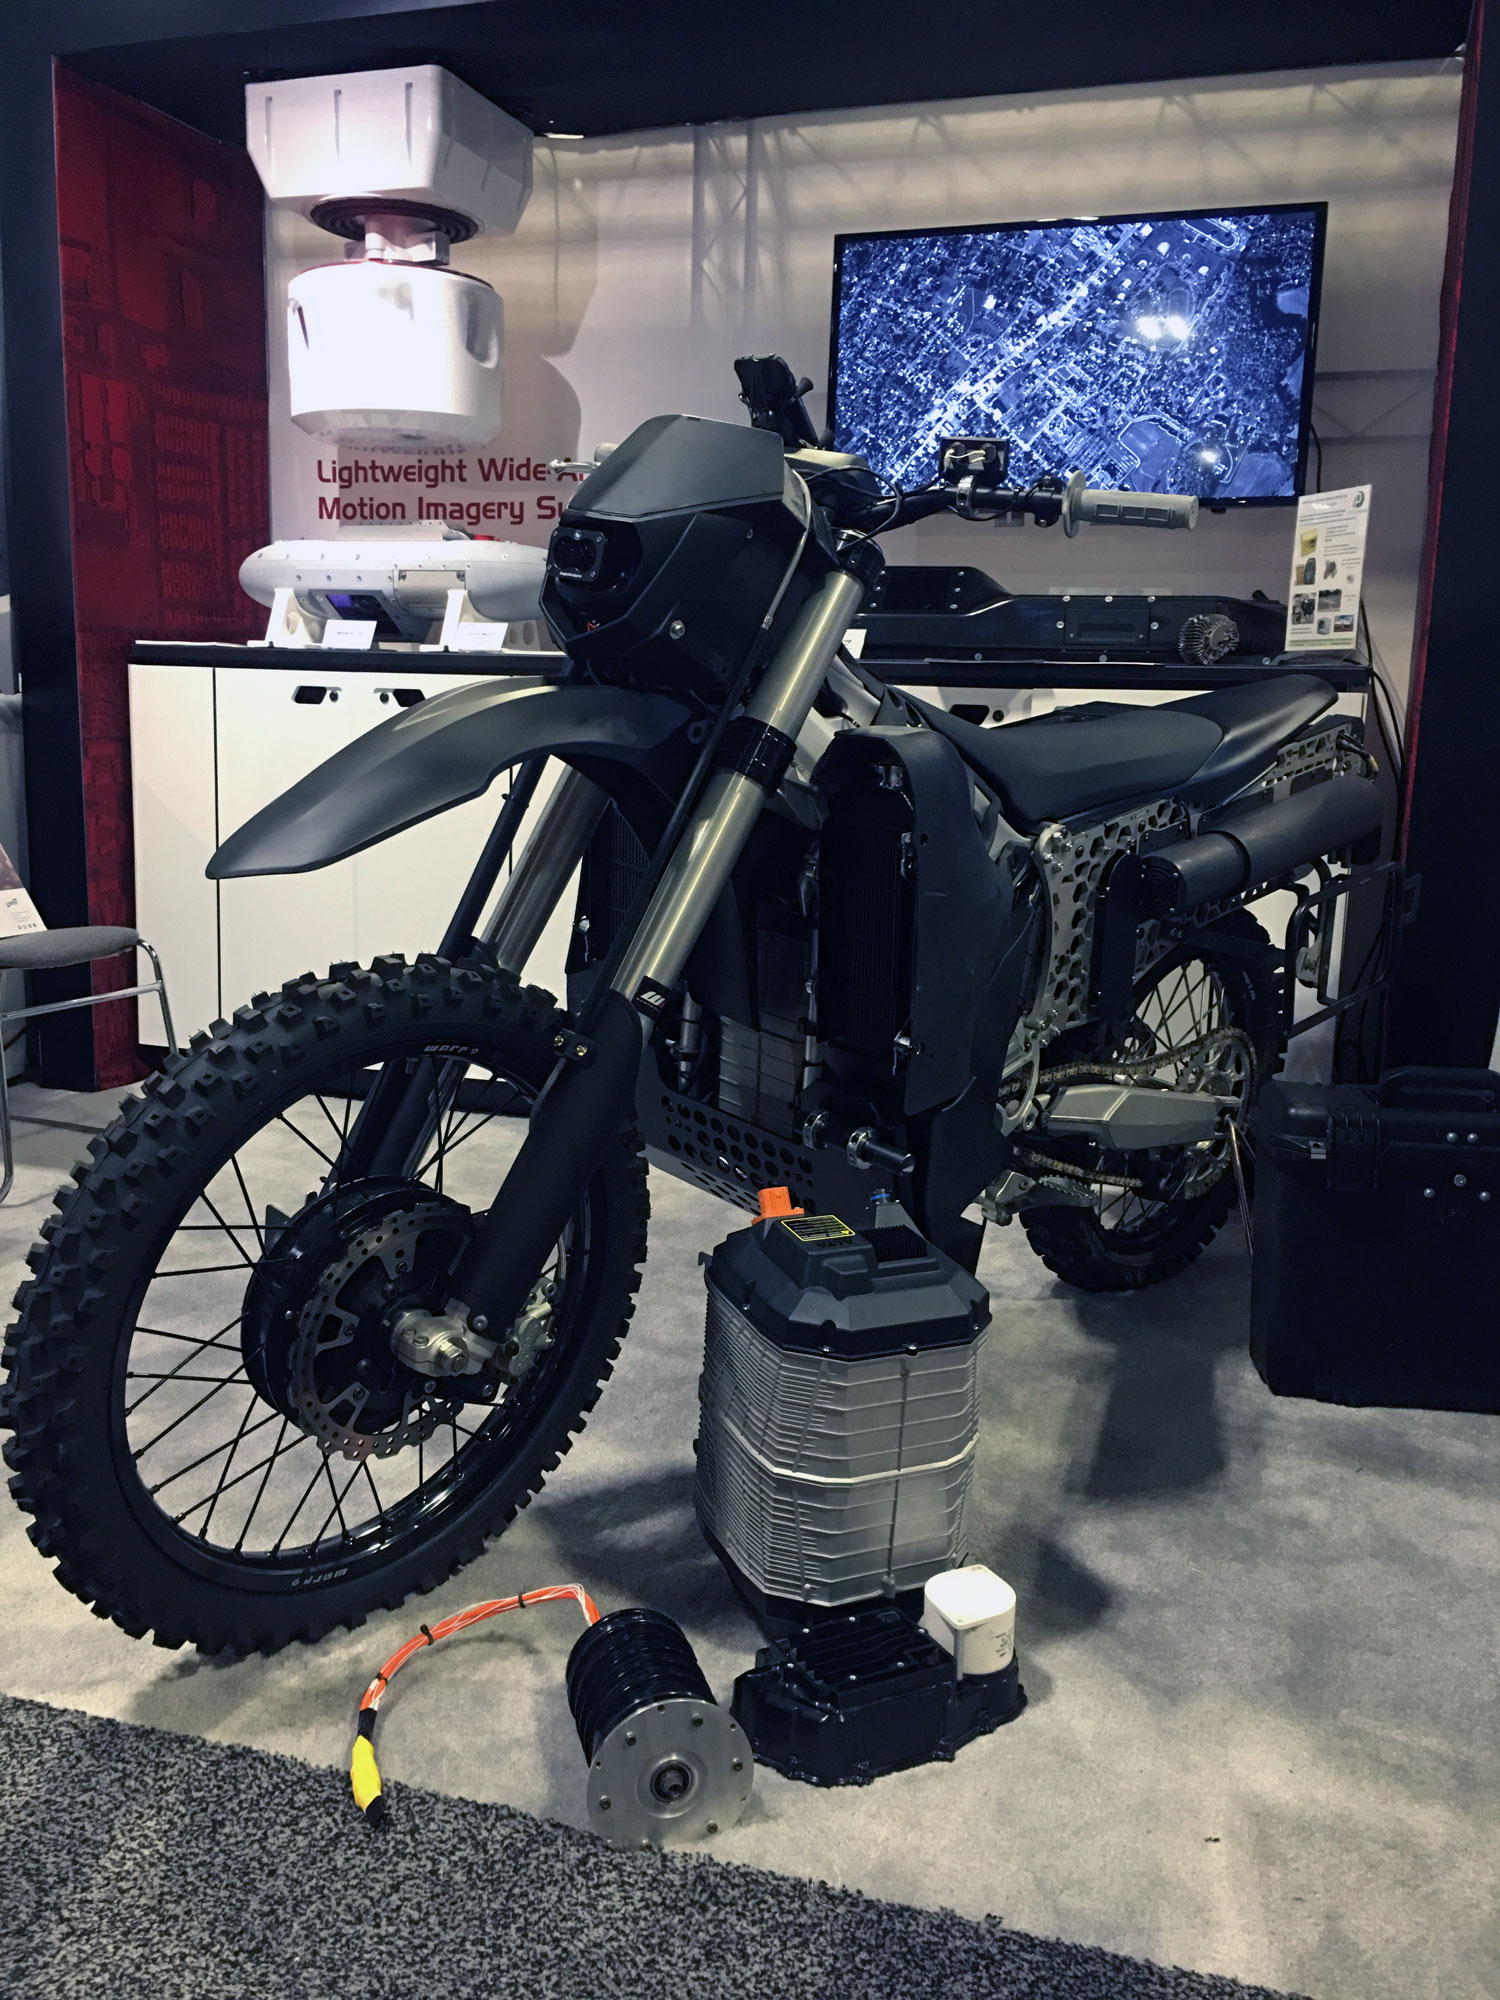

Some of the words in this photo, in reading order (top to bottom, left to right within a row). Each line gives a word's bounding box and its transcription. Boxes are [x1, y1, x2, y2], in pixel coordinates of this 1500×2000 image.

[317, 459, 467, 489] Lightweight
[318, 497, 406, 520] Motion
[418, 496, 524, 526] Imagery
